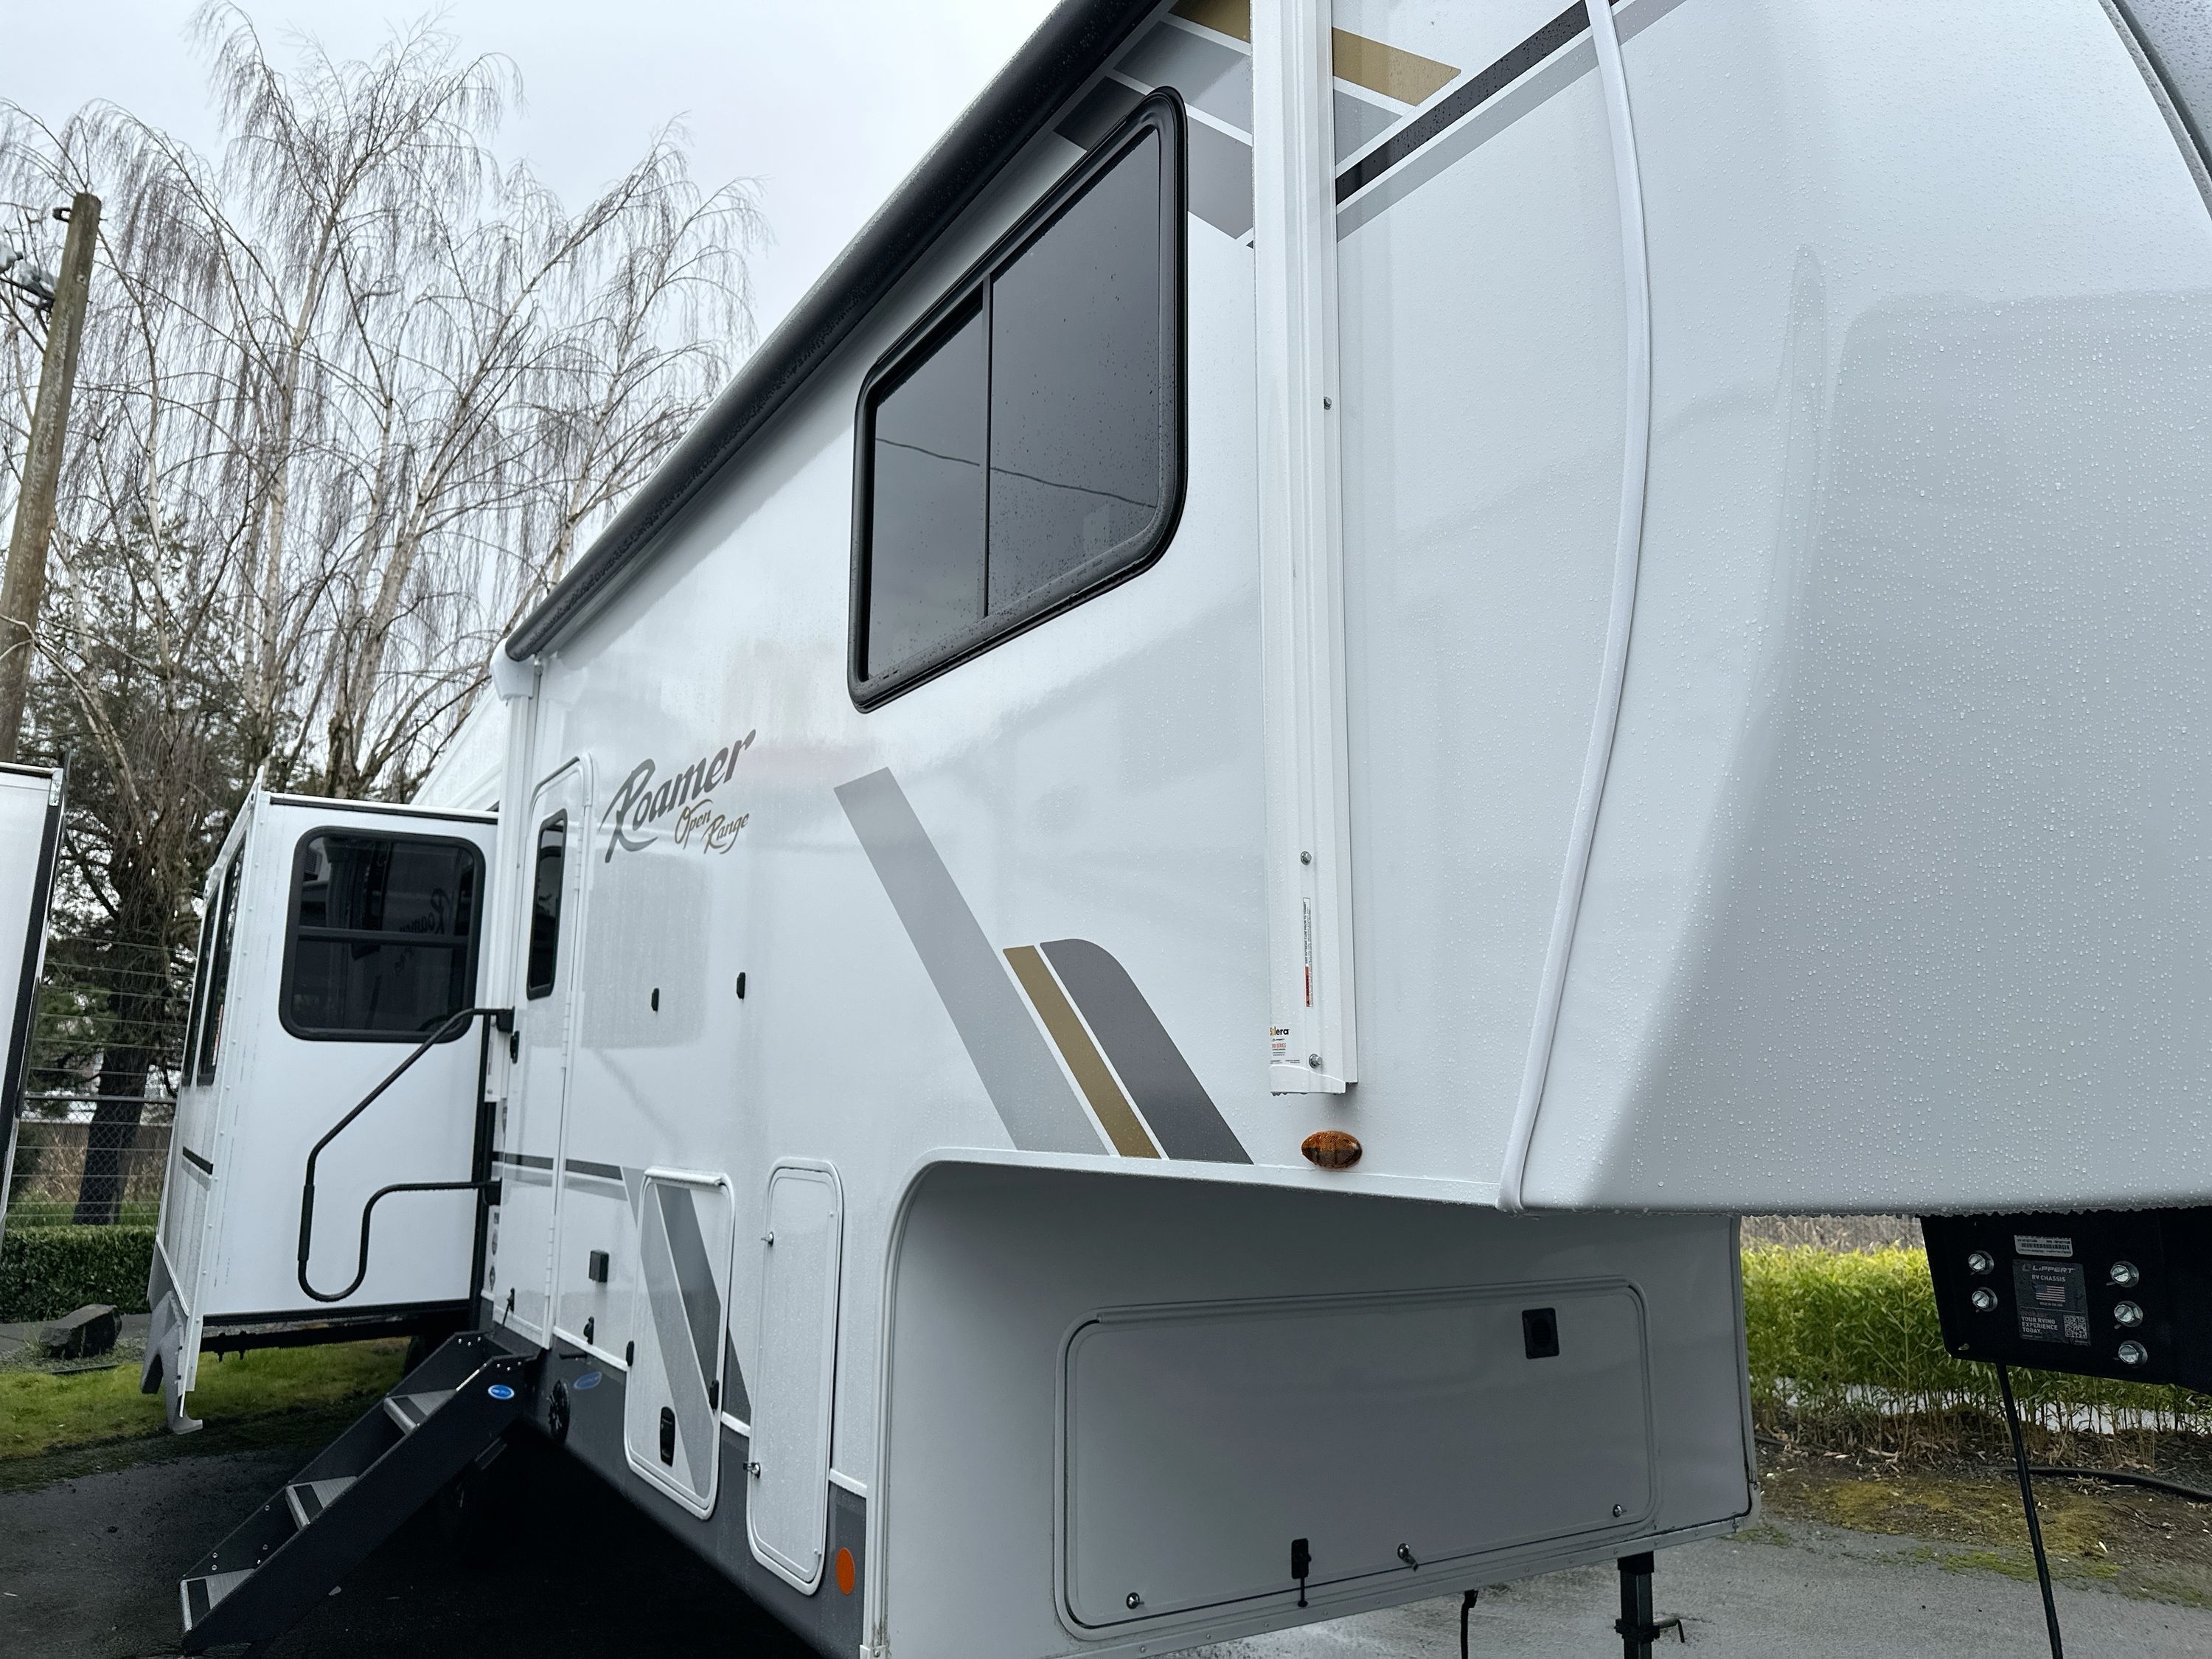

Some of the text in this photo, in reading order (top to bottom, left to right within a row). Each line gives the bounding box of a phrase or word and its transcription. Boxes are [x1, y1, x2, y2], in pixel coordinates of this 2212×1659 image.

[599, 729, 757, 863] Roamer
[675, 799, 750, 855] Open Range
[2022, 1321, 2059, 1331] EXPERIENCE
